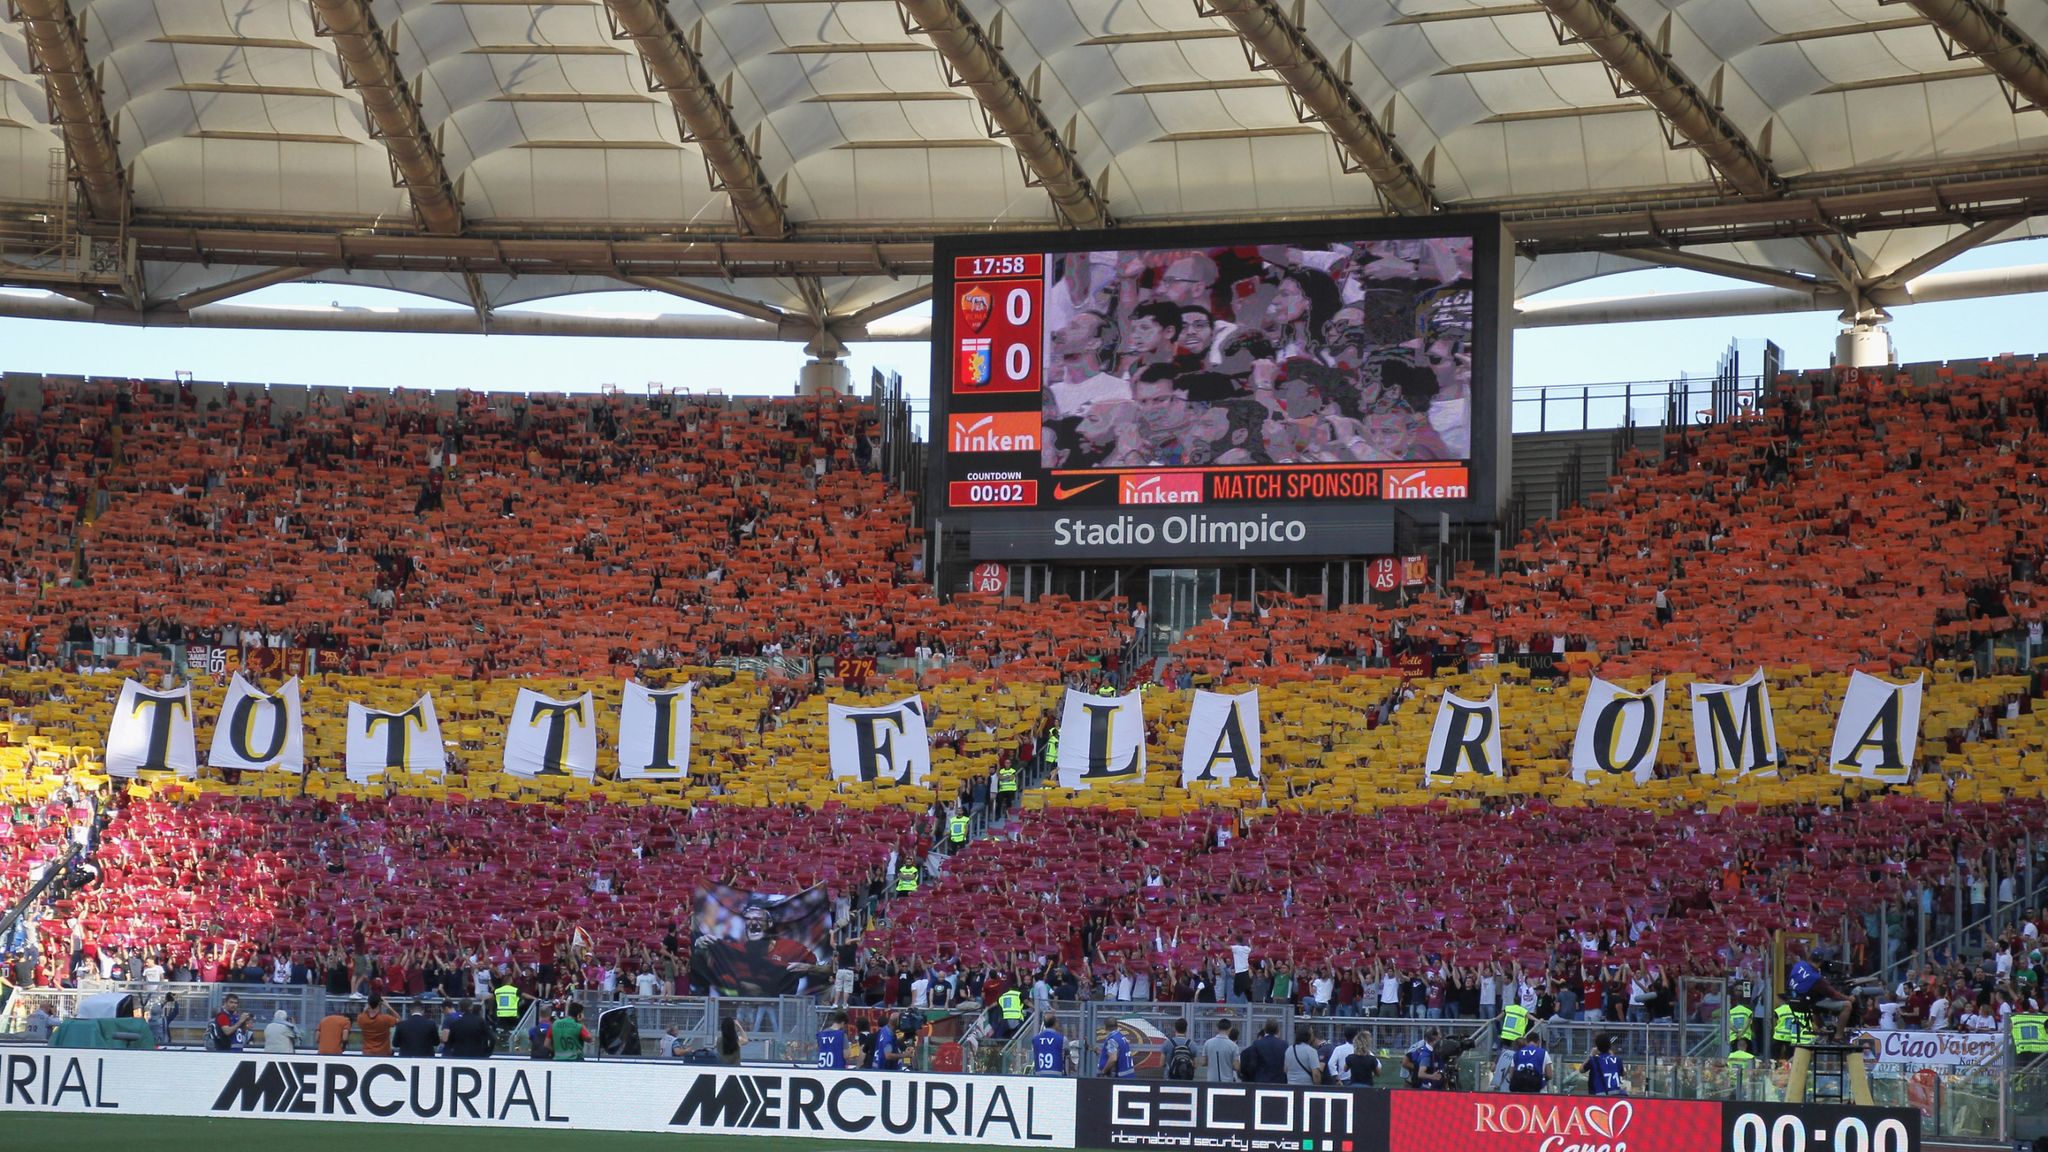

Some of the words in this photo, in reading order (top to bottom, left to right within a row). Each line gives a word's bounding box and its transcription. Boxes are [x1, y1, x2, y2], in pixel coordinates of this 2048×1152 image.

[973, 257, 1024, 275] 17:58
[1006, 288, 1031, 325] 0
[1005, 343, 1031, 381] 0
[955, 415, 1034, 452] linkem
[967, 472, 1022, 481] COUNTDOWN
[1213, 474, 1281, 499] MATCH
[1287, 472, 1378, 498] SPONSOR
[1390, 470, 1466, 499] linkem
[970, 485, 1023, 502] 00:02
[1126, 476, 1199, 504] linkem
[1054, 515, 1155, 546] Stadio
[1162, 513, 1306, 550] Olimpico
[983, 563, 1000, 577] 20
[1377, 559, 1393, 573] 19
[980, 577, 1002, 592] AD
[1375, 573, 1394, 588] AS
[839, 660, 875, 678] 27%
[1429, 681, 1912, 779] ROMA
[822, 1036, 835, 1044] TV
[1040, 1037, 1055, 1045] TV
[1885, 1032, 1938, 1059] Ciao
[818, 1052, 834, 1067] 50
[0, 1054, 119, 1108] RIAL
[211, 1060, 570, 1123] MERCURIAL
[1604, 1072, 1620, 1088] 71
[669, 1073, 1053, 1141] MERCURIAL
[1474, 1102, 1591, 1137] ROMA
[1111, 1130, 1191, 1146] international
[1194, 1134, 1249, 1152] security
[1252, 1138, 1300, 1151] service
